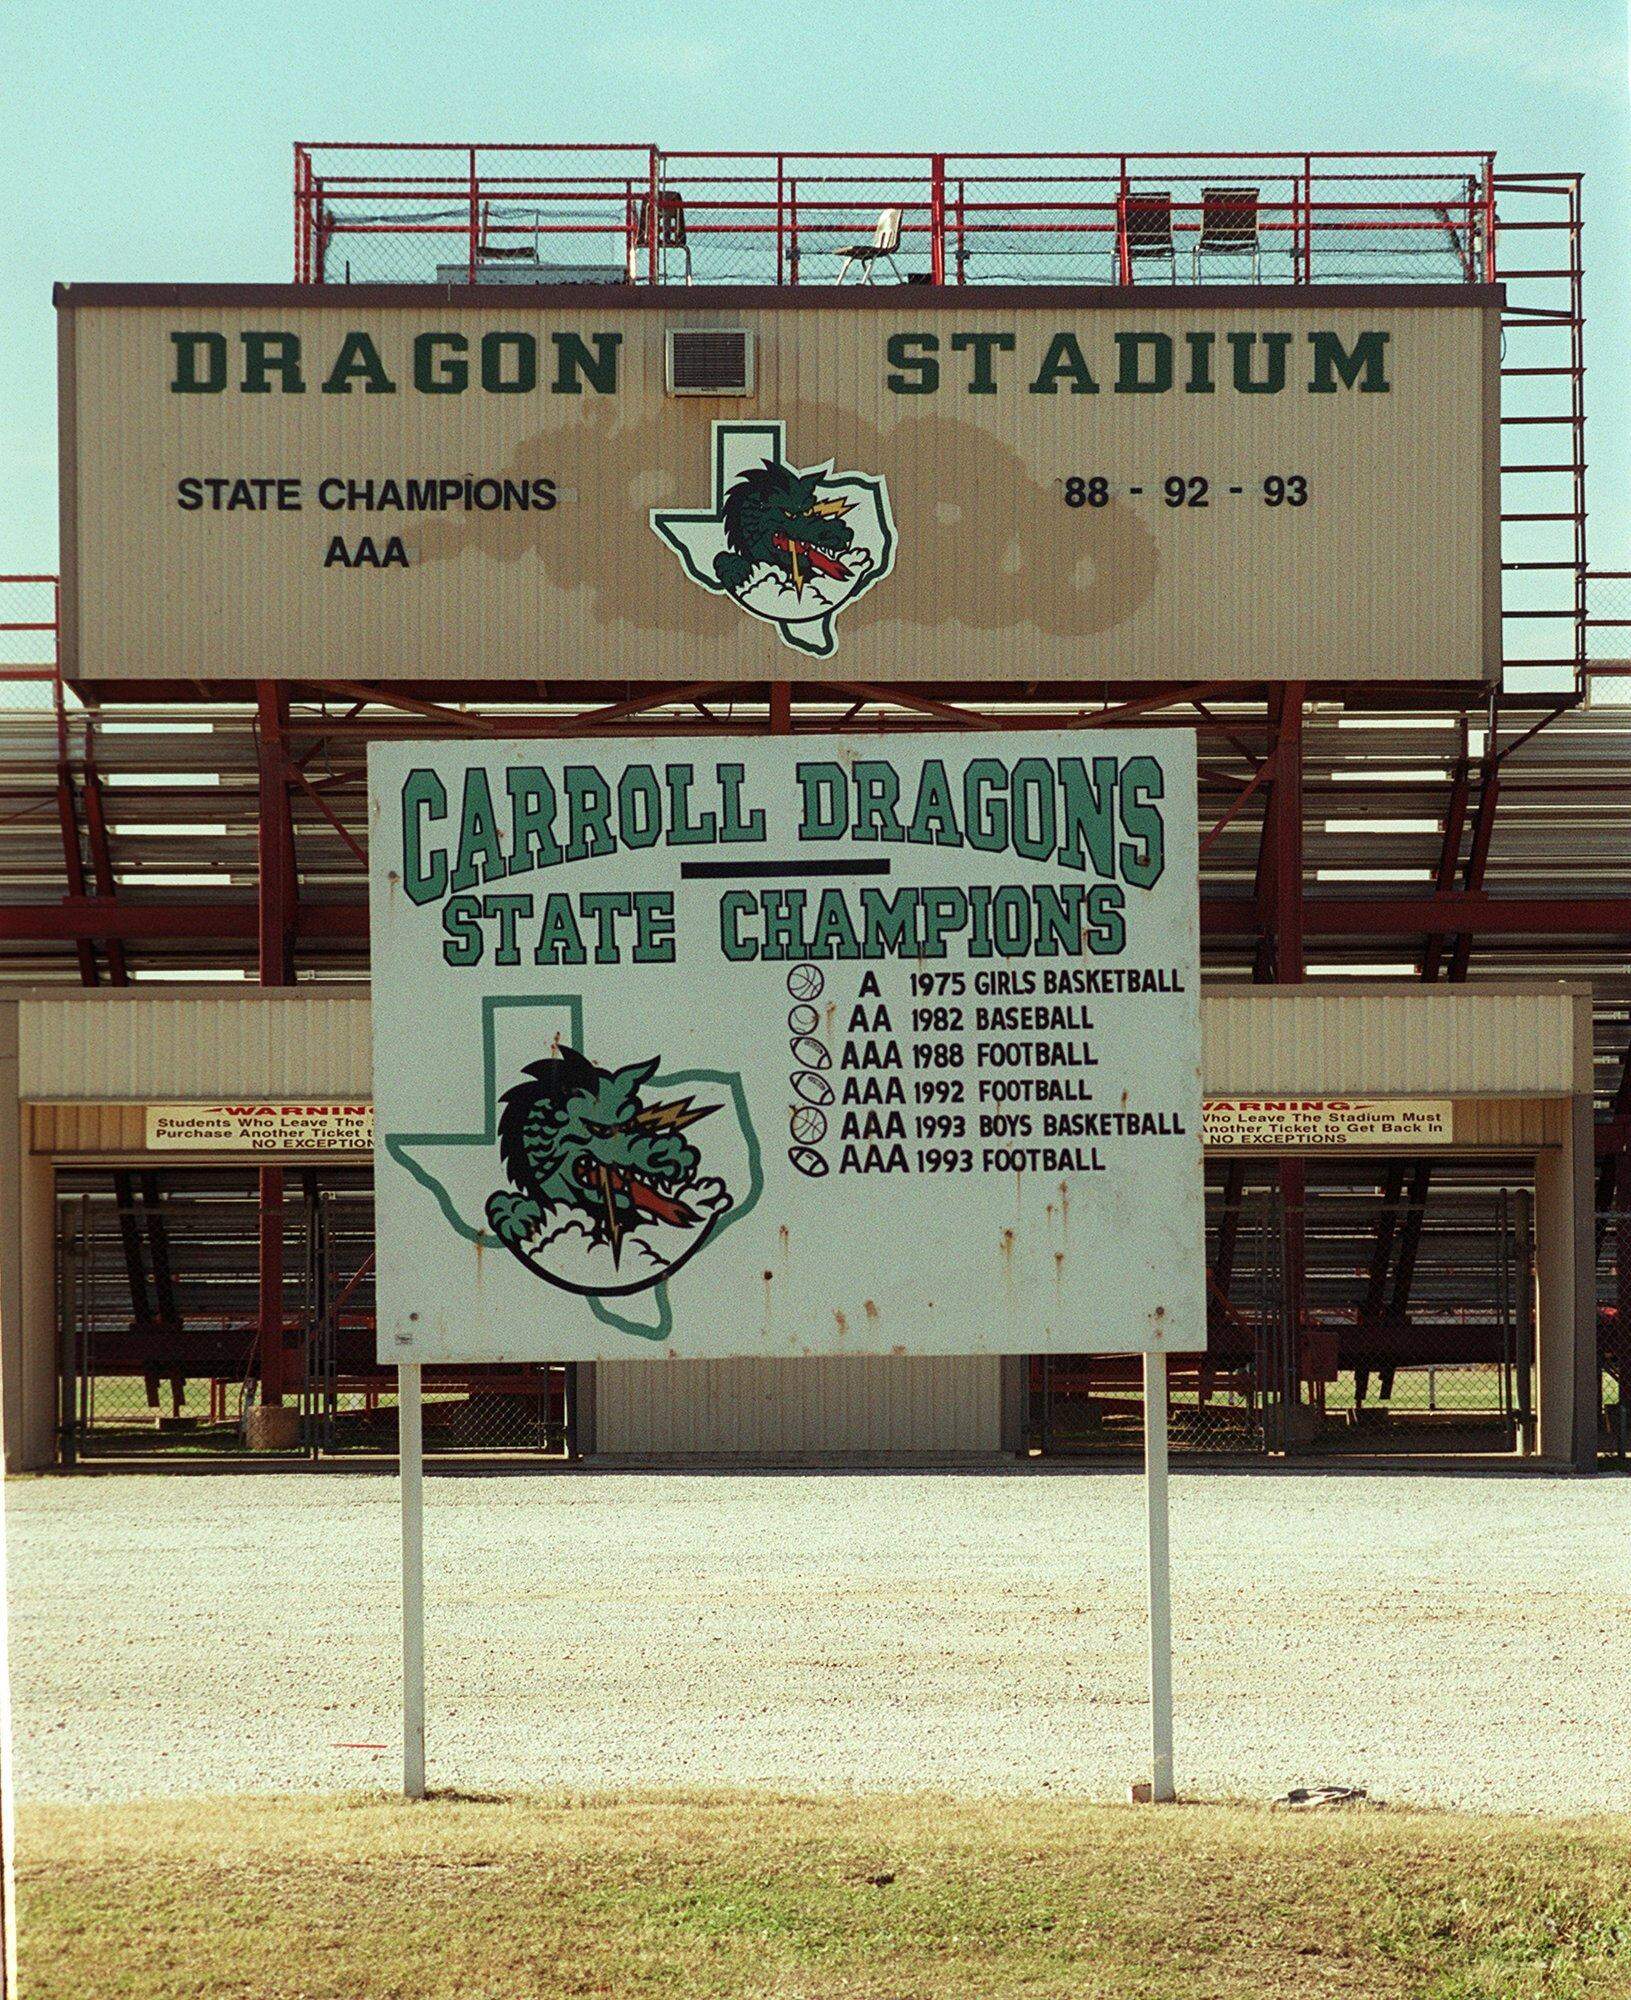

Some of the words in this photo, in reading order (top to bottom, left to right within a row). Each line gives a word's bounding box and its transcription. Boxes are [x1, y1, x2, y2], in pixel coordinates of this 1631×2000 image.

[170, 330, 623, 395] DRAGON
[886, 330, 1391, 396] STADIUM
[177, 477, 303, 511] STATE
[318, 477, 558, 512] CHAMPIONS
[1163, 475, 1209, 508] 92
[1263, 474, 1308, 508] 93
[323, 535, 410, 569] AAA
[400, 762, 767, 908] CARROLL
[796, 755, 1166, 891] DRAGONS
[441, 890, 677, 968] STATE
[719, 884, 1127, 964] CHAMPIONS
[858, 970, 882, 998] A
[909, 971, 967, 997] 1975
[974, 970, 1037, 996] GIRLS
[1043, 969, 1186, 995] BASKETBALL
[847, 1003, 893, 1033] AA
[911, 1006, 965, 1032] 1982
[975, 1005, 1095, 1031] BASEBALL
[840, 1039, 904, 1071] AAA
[912, 1042, 965, 1069] 1988
[977, 1041, 1099, 1068] FOOTBALL
[841, 1076, 907, 1106] AAA
[913, 1079, 965, 1105] 1992
[978, 1078, 1093, 1102] FOOTBALL
[158, 1118, 231, 1127] Students
[238, 1118, 273, 1127] Who
[281, 1118, 328, 1127] Leave
[335, 1118, 364, 1127] The
[225, 1106, 374, 1116] WARNIN
[840, 1109, 907, 1141] AAA
[915, 1114, 966, 1139] 1993
[979, 1114, 1033, 1138] BOYS
[1043, 1112, 1186, 1137] BASKETBALL
[1238, 1113, 1285, 1123] Leave
[1292, 1113, 1321, 1123] The
[1329, 1112, 1395, 1122] Stadium
[1403, 1112, 1441, 1122] Must
[156, 1129, 233, 1138] Purchase
[239, 1129, 304, 1138] Another
[311, 1128, 360, 1138] Ticket
[1210, 1135, 1234, 1144] NO
[1241, 1134, 1348, 1144] EXCEPTIONS
[1269, 1123, 1317, 1133] Ticket
[1324, 1124, 1340, 1133] to
[1347, 1123, 1377, 1133] Get
[1382, 1123, 1421, 1133] Back
[1428, 1123, 1443, 1133] In
[252, 1139, 277, 1149] NO
[838, 1143, 910, 1174] AAA
[916, 1148, 974, 1173] 1993
[982, 1147, 1106, 1173] FOOTBALL
